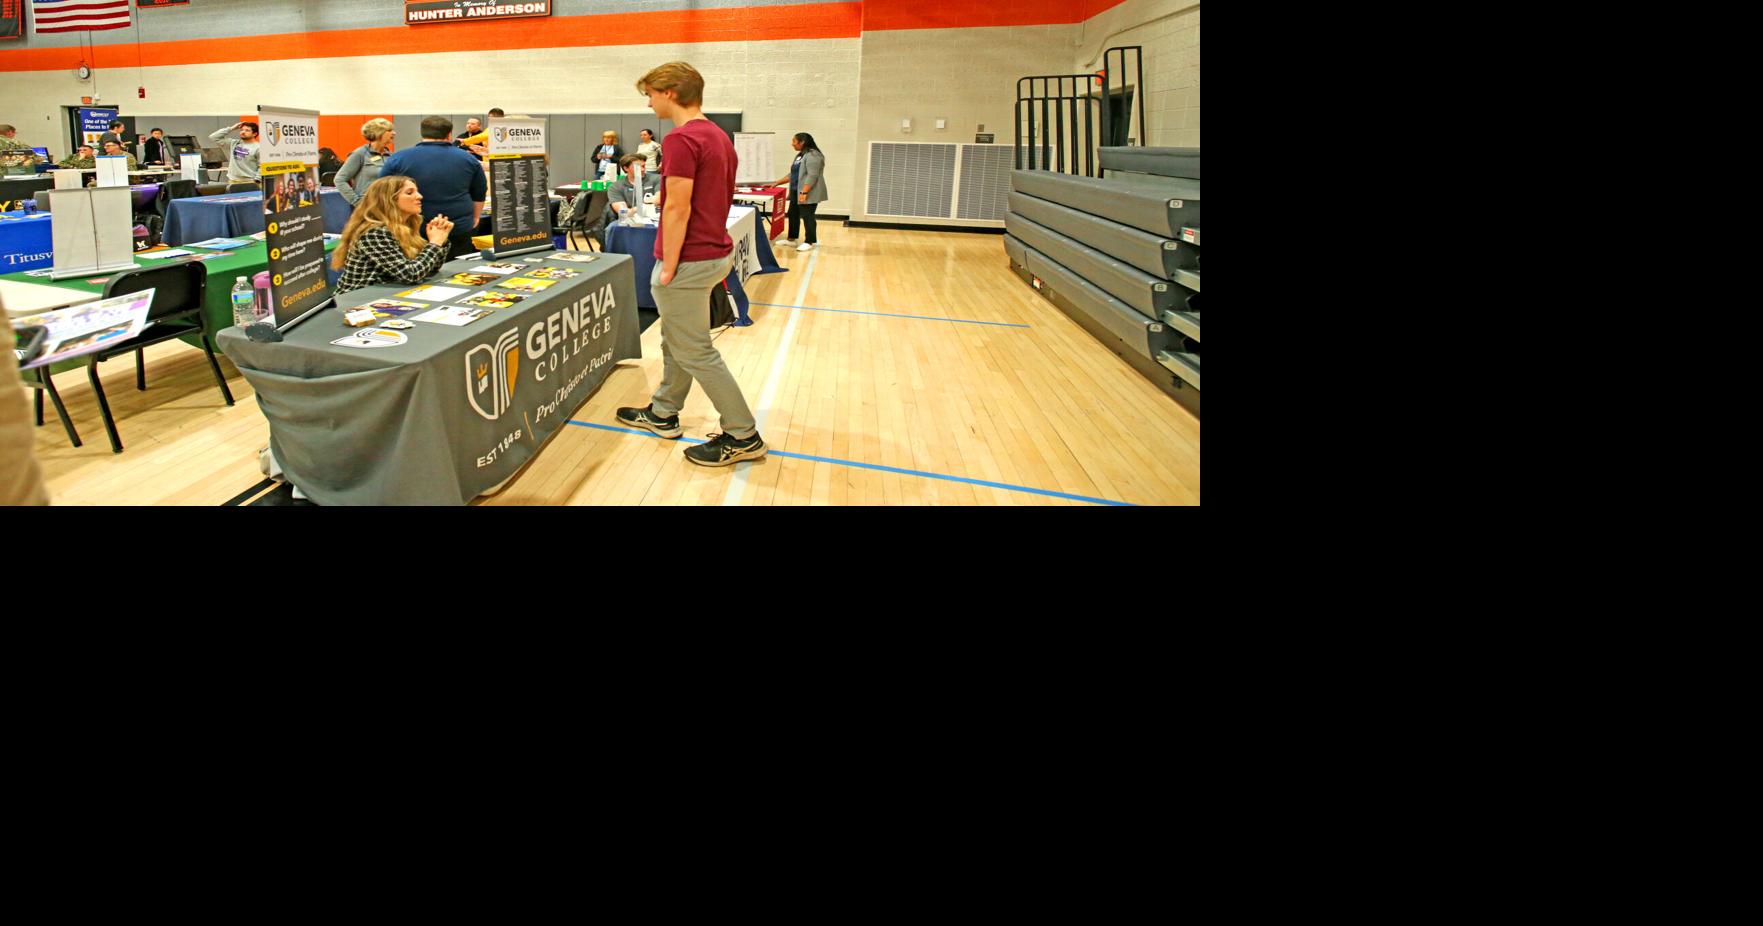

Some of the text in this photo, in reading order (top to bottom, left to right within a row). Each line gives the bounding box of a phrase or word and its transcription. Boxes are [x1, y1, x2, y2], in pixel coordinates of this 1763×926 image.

[409, 2, 546, 20] HUNTER ANDERSON
[281, 125, 315, 136] GENEVA
[509, 128, 541, 137] GENEVA
[500, 232, 547, 245] Geneva.edu
[282, 278, 326, 308] Geneva.edu
[526, 284, 616, 360] GENEVA
[535, 316, 611, 382] COLLEGE
[536, 401, 556, 424] Pro
[556, 377, 581, 406] Christo
[477, 429, 522, 468] EST 1848
